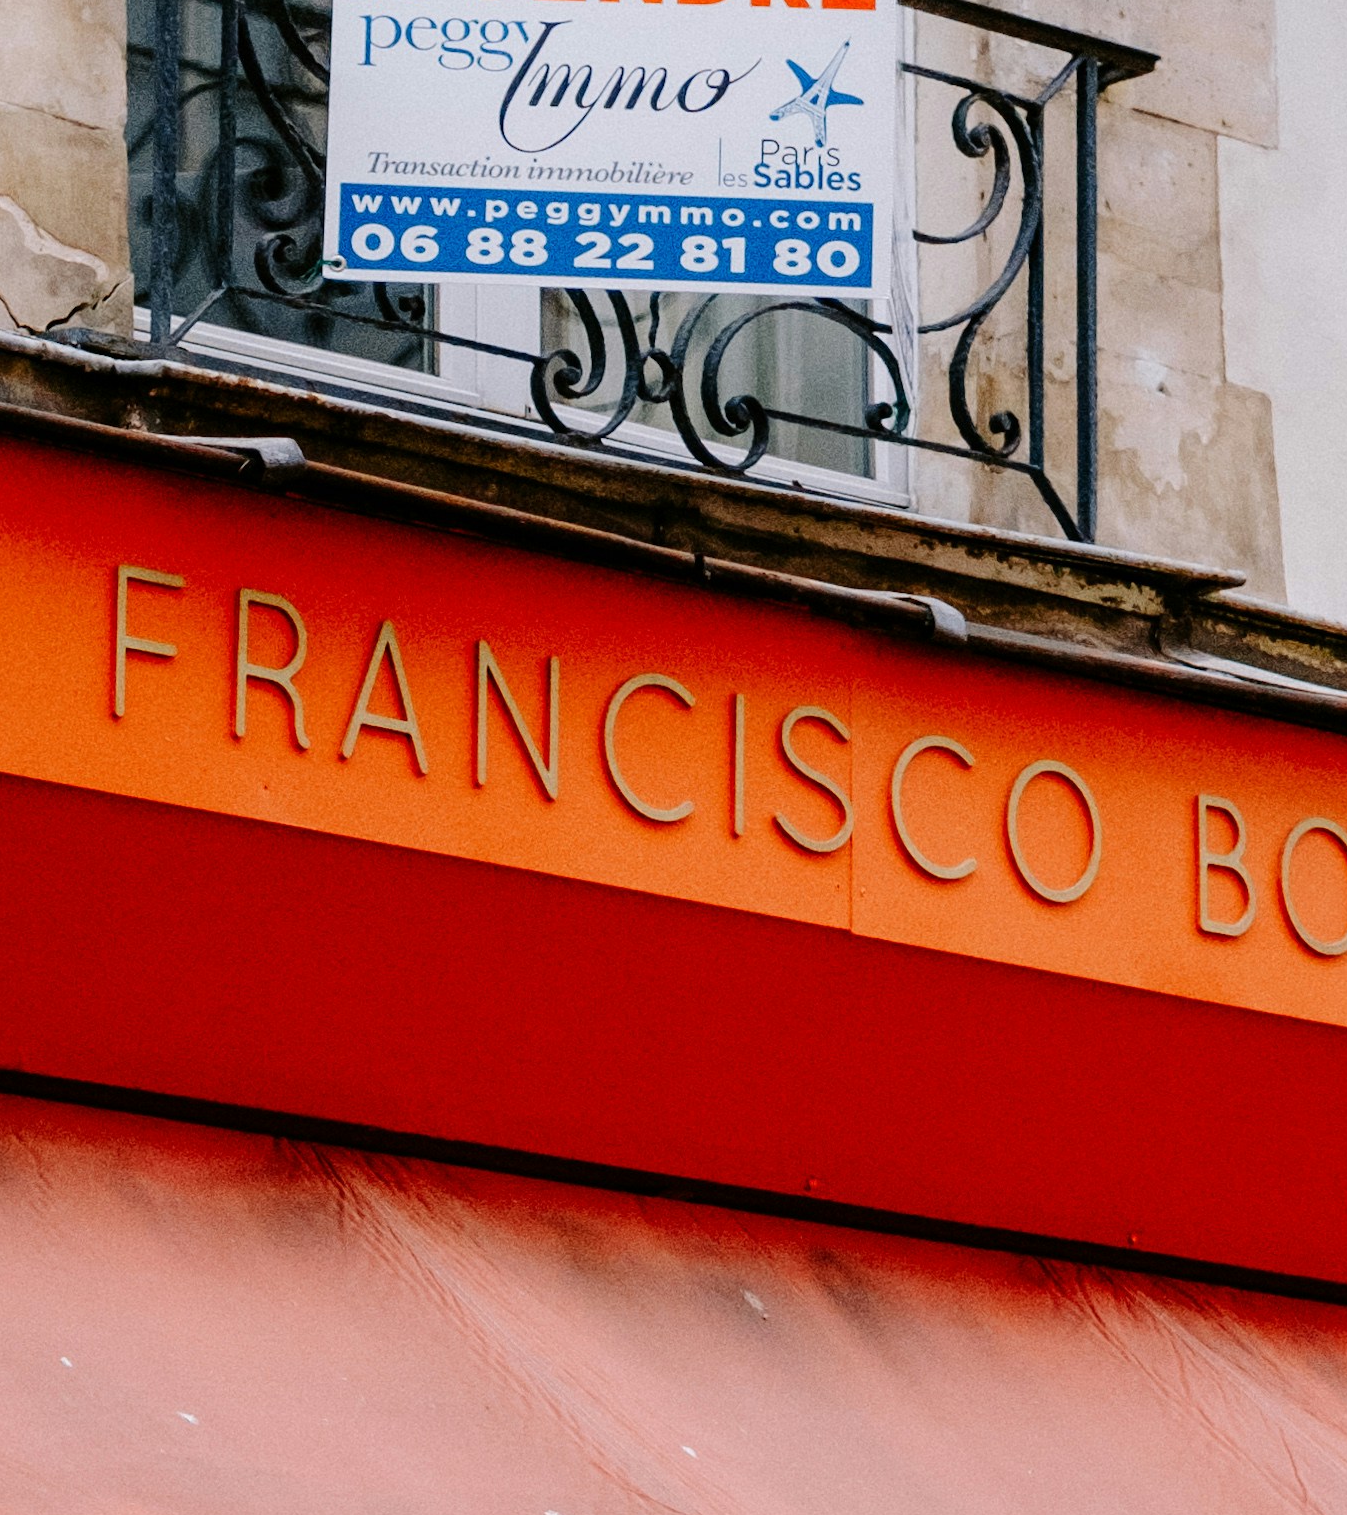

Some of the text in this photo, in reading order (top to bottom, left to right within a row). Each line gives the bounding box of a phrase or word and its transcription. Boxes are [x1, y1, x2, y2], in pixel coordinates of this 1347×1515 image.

[366, 149, 694, 187] Transaction immobilière
[758, 138, 841, 168] Paris
[753, 163, 862, 192] Sables
[351, 192, 863, 233] www.peggymmo.com
[350, 223, 860, 278] 06 88 22 81 80
[111, 563, 1103, 906] FRANCISCO
